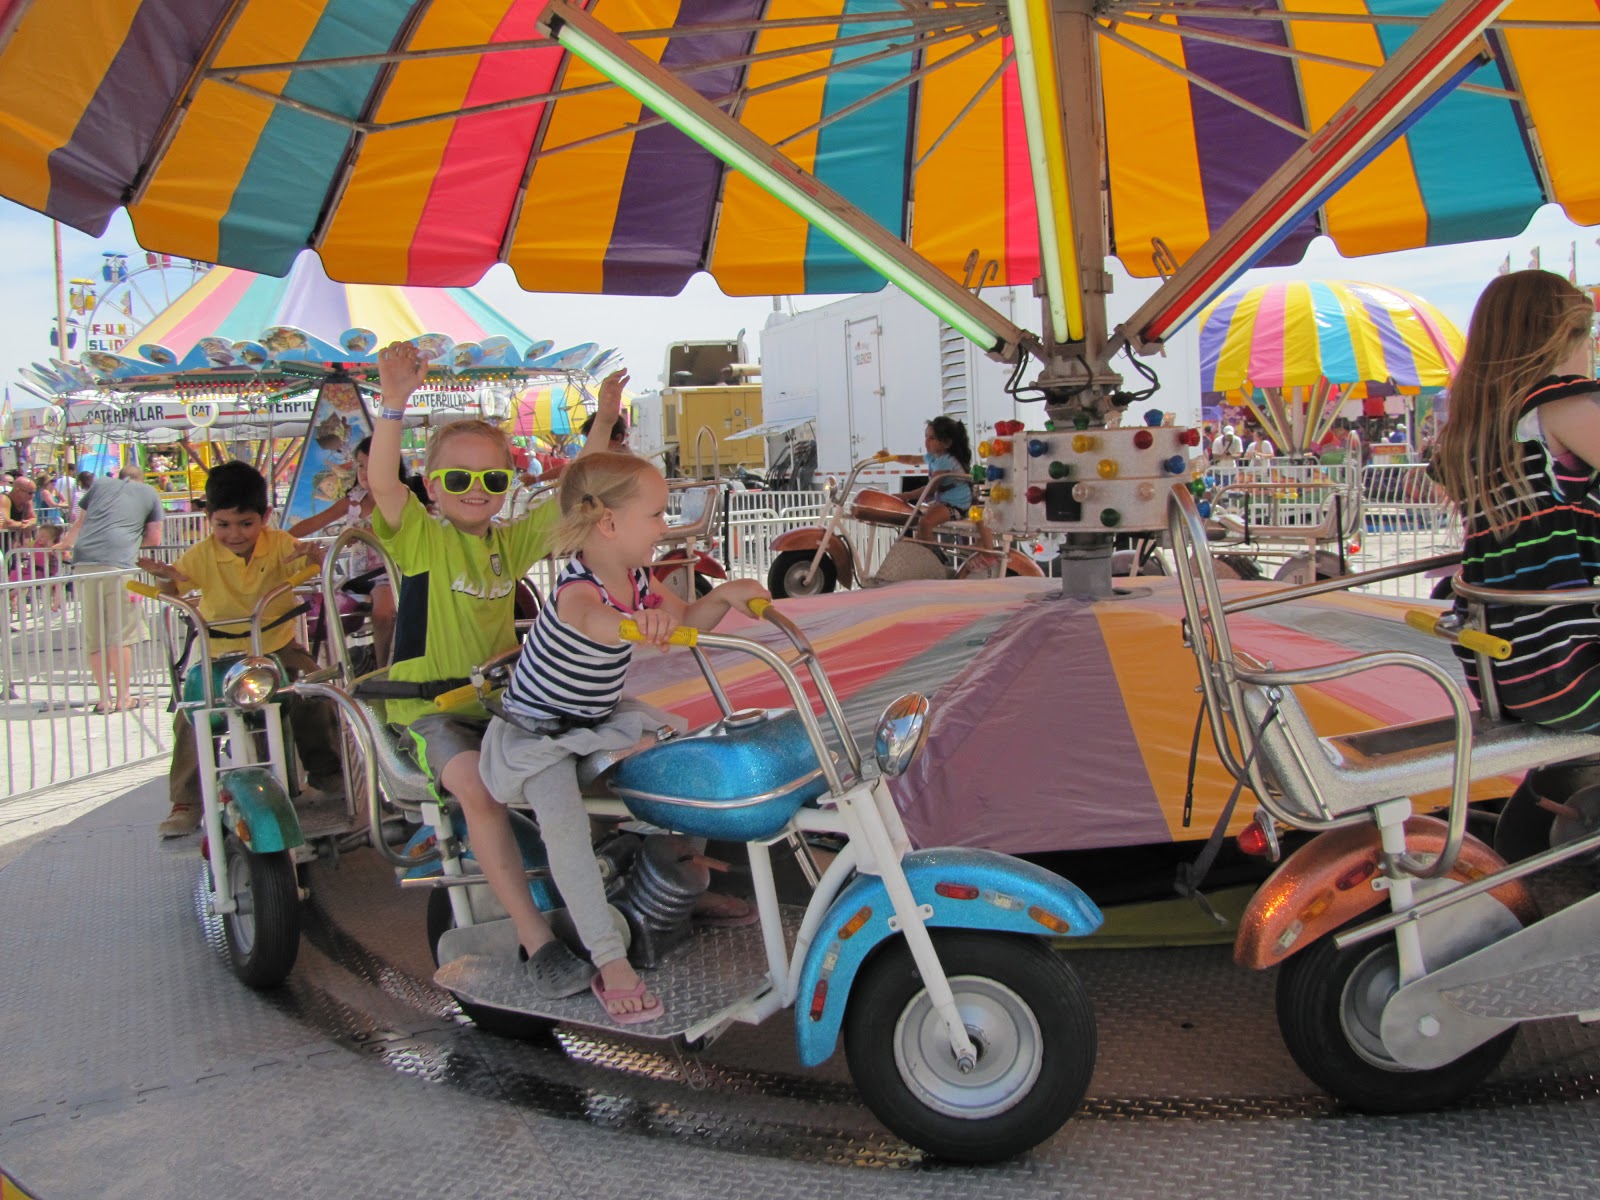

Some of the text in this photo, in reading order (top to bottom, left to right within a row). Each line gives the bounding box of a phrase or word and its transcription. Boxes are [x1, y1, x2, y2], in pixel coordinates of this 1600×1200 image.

[92, 324, 126, 335] FUN
[89, 340, 128, 350] SLID
[412, 393, 468, 408] CATERPILLAR
[87, 405, 165, 425] CATERPILLAR
[191, 404, 211, 417] CAT
